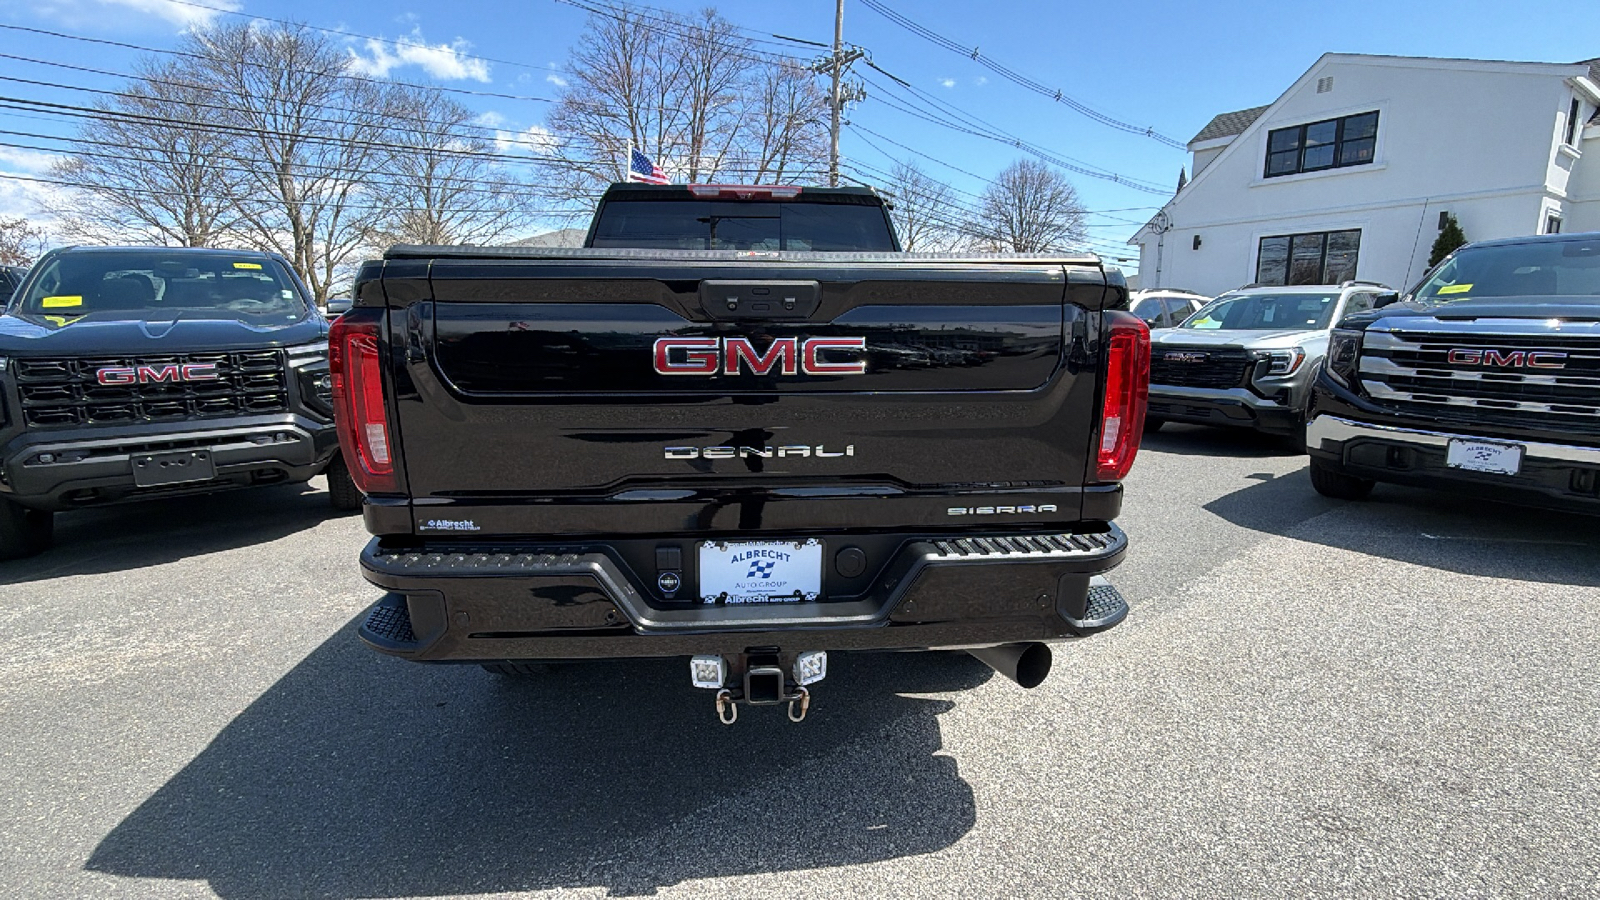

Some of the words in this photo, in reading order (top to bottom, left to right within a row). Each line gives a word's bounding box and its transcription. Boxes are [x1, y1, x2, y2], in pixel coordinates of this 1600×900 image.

[653, 337, 868, 375] GMC
[1164, 352, 1205, 363] GMC
[1447, 348, 1568, 369] GMC
[97, 362, 219, 385] GMC
[664, 445, 854, 459] DENALI
[1466, 446, 1502, 455] ALBRECHT
[947, 504, 1058, 515] SIERRA
[731, 549, 791, 563] ALBRECHT
[725, 593, 769, 604] Albrecht
